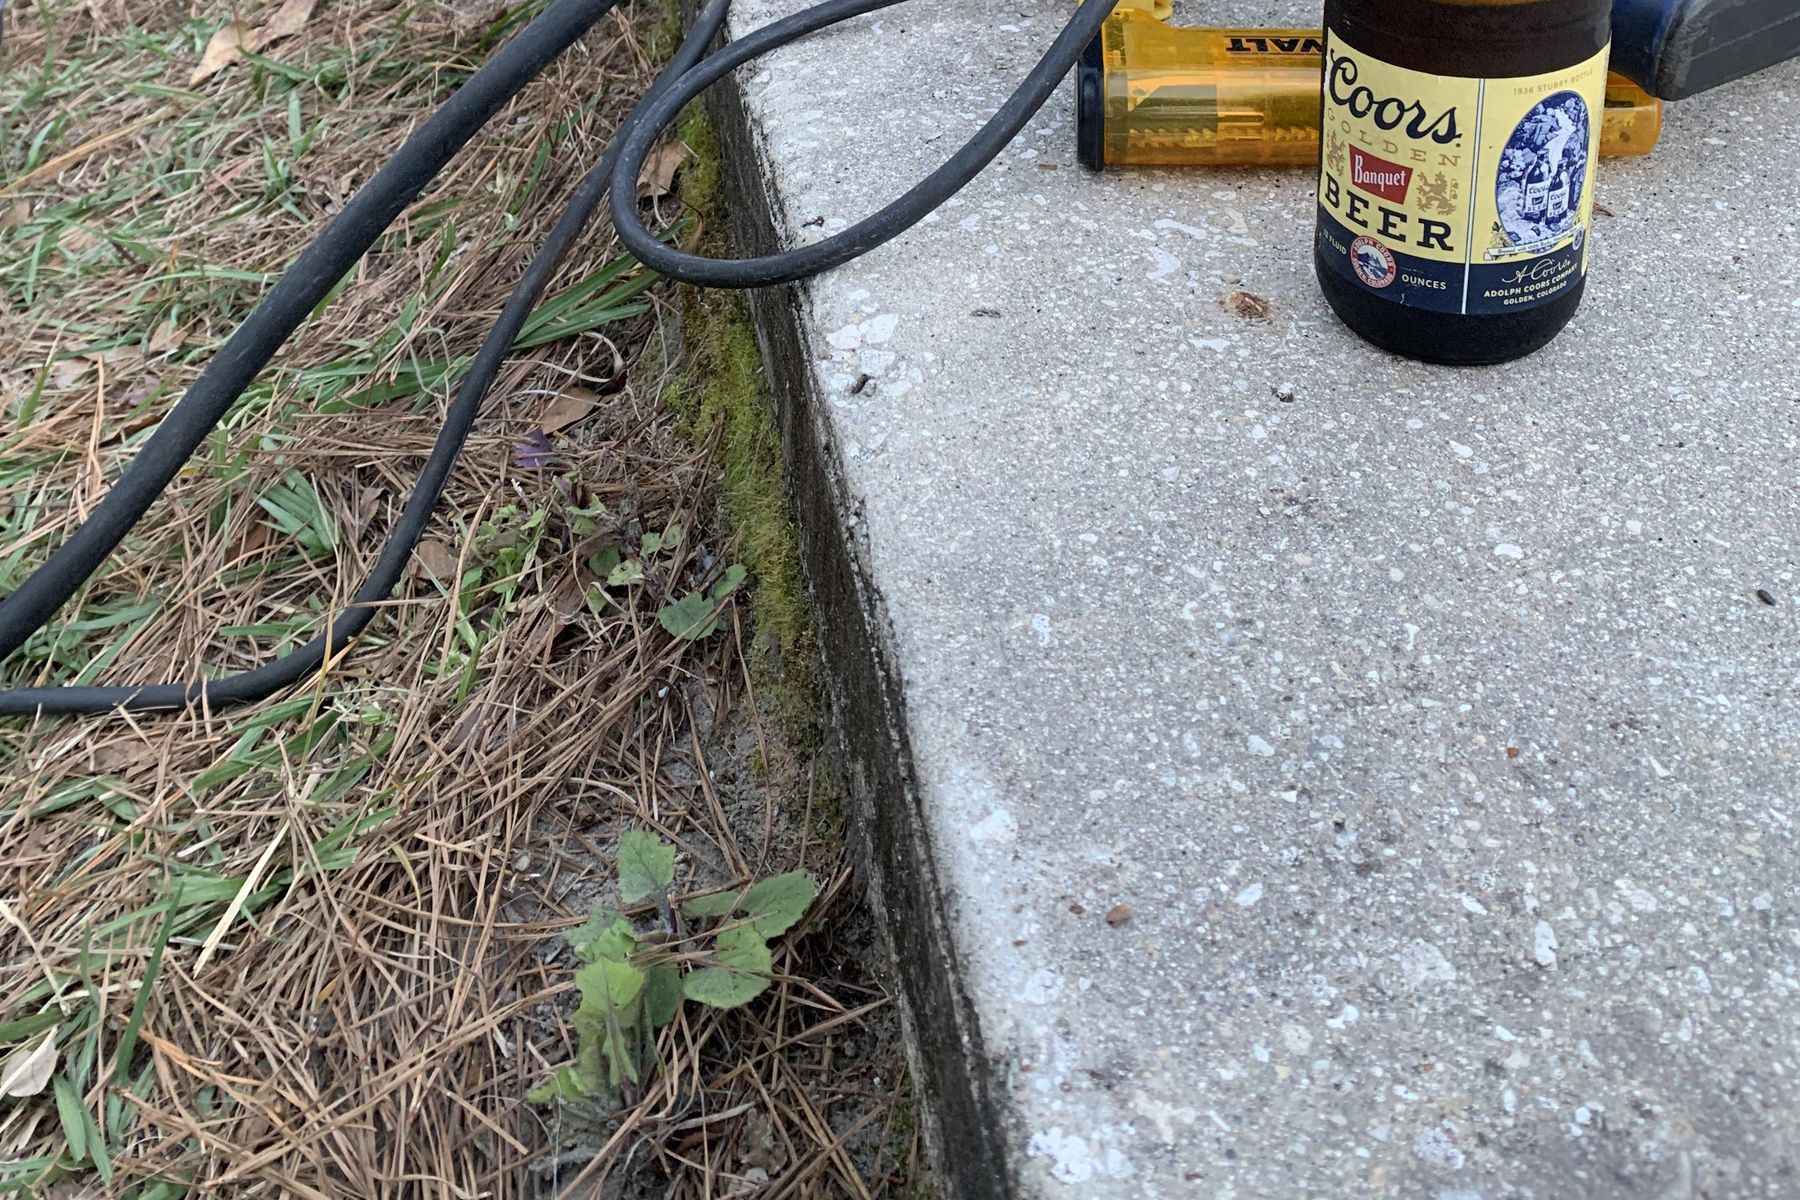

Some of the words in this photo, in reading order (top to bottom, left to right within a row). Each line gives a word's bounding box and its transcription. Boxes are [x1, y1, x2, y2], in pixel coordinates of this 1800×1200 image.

[1329, 48, 1462, 144] Coors
[1537, 79, 1568, 93] STUBBY
[1327, 107, 1462, 167] GOLDEN
[1354, 154, 1406, 193] Banquet
[1325, 171, 1455, 252] BEER
[1329, 234, 1347, 255] FLUID
[1401, 273, 1447, 290] OUNCES
[1484, 287, 1521, 298] ADOLPH
[1524, 279, 1550, 293] COORS
[1552, 262, 1578, 284] COMPANY
[1503, 294, 1535, 306] GOLDEN,
[1536, 280, 1567, 299] COLORADO
